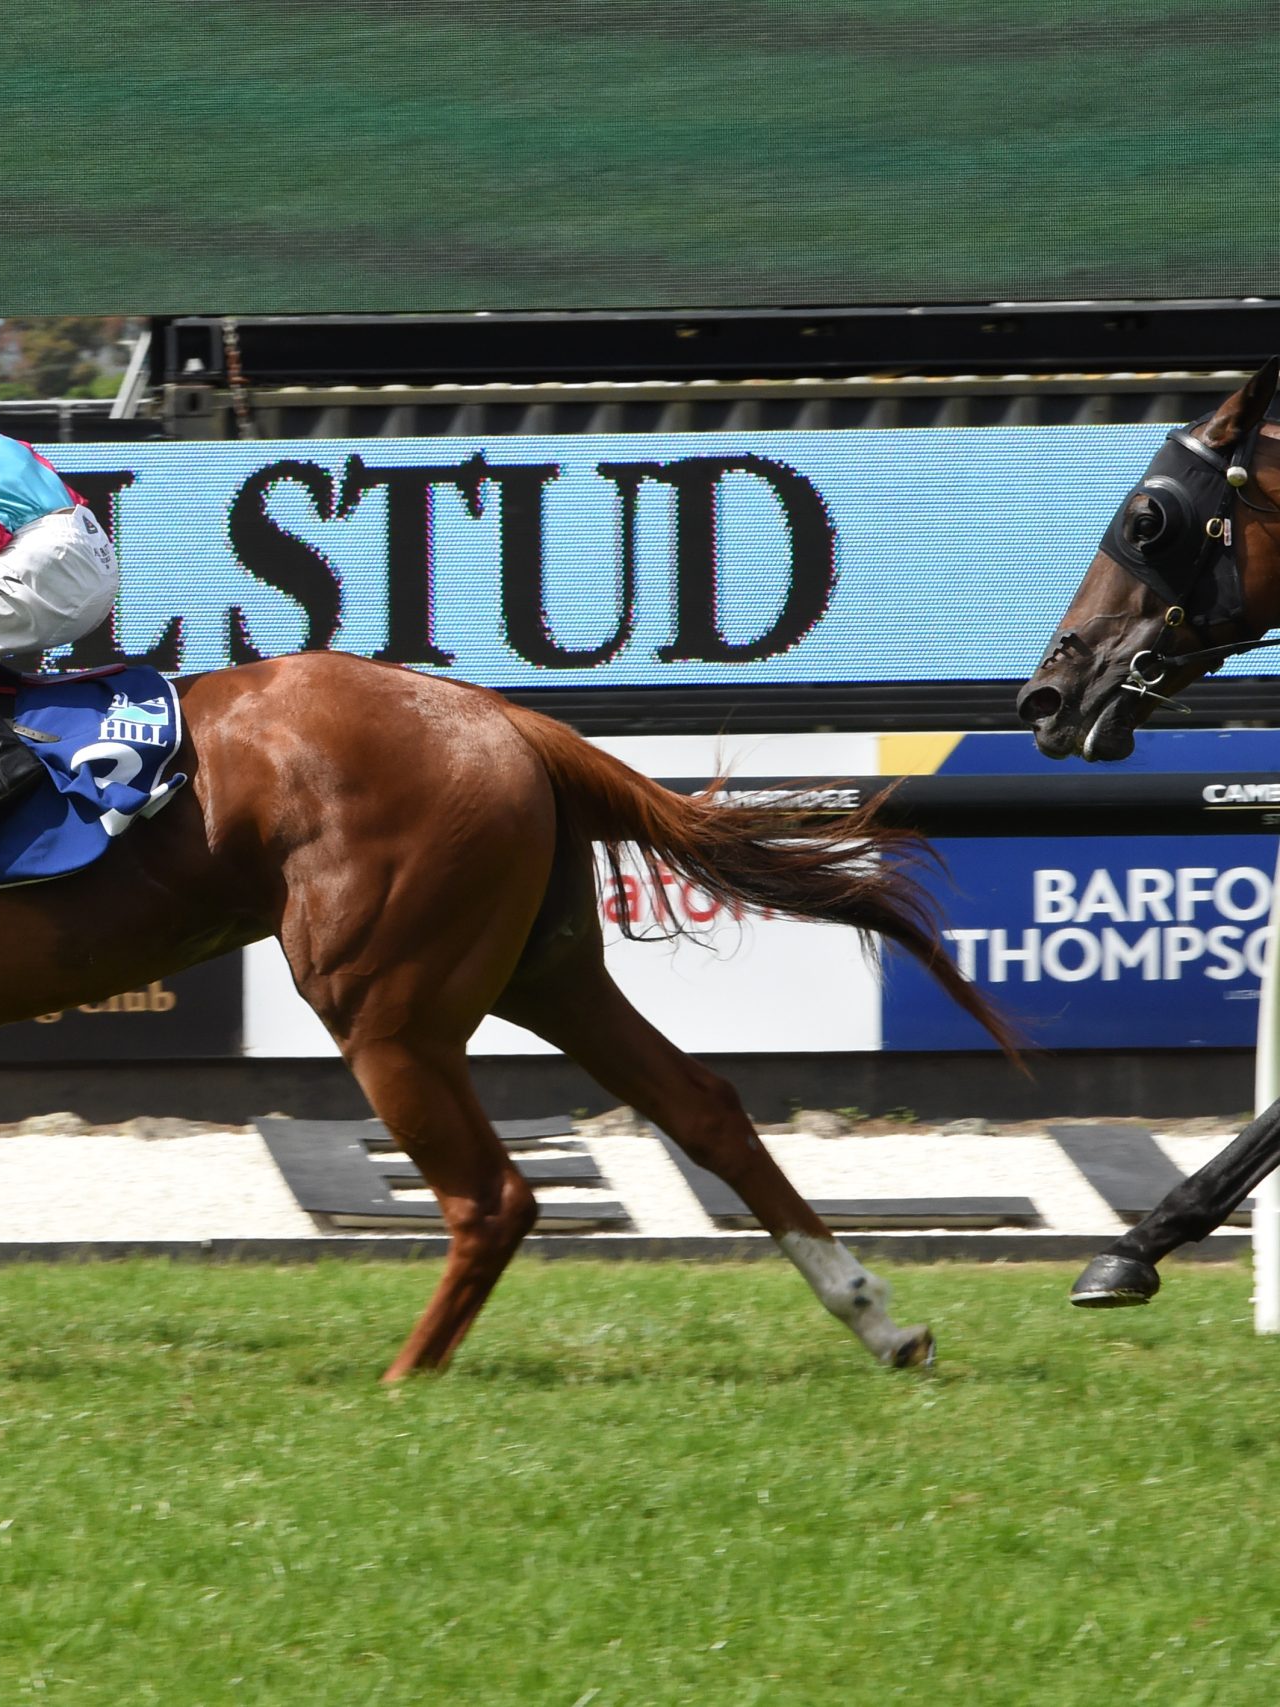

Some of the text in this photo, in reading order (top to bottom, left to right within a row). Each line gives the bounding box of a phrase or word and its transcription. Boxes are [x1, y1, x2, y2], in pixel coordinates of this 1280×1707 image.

[227, 452, 840, 670] STUD
[98, 718, 168, 748] HILL
[1033, 866, 1273, 923] BARFO
